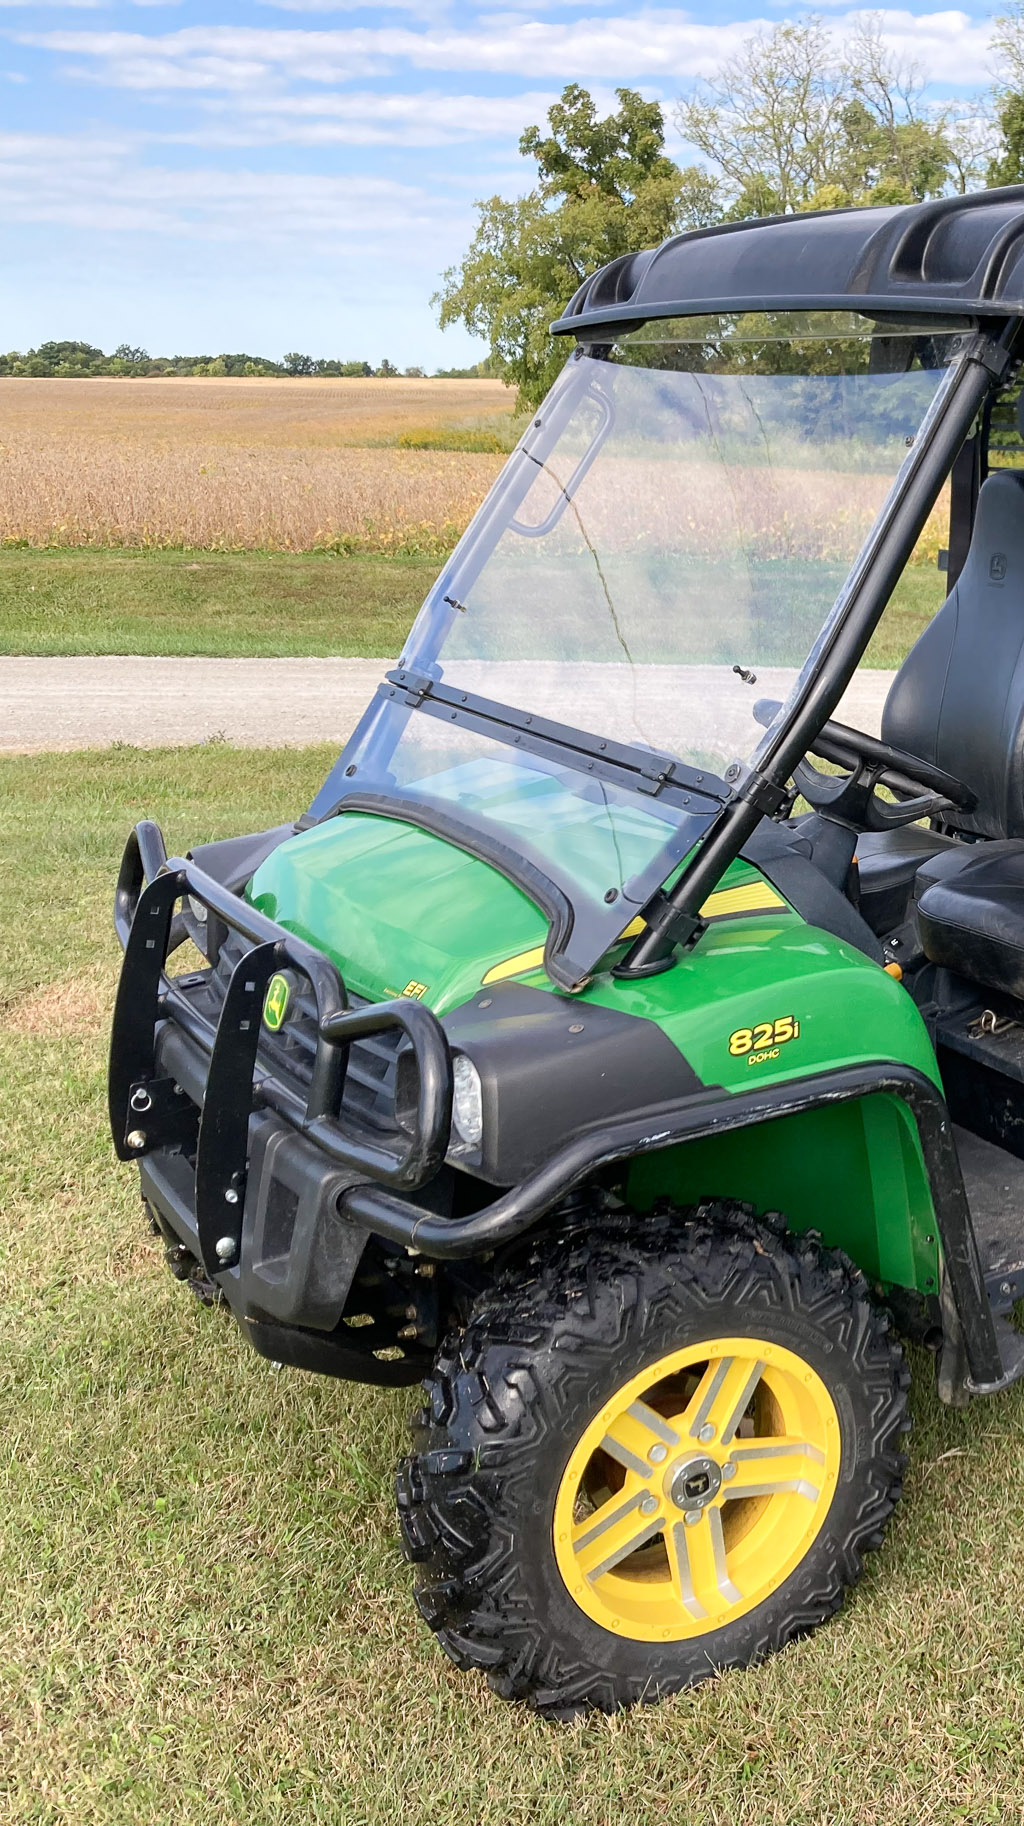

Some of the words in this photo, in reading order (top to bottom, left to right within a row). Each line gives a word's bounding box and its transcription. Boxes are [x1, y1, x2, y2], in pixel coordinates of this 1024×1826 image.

[402, 979, 428, 1001] EFI
[729, 1015, 799, 1056] 825i
[747, 1048, 780, 1066] DOHC
